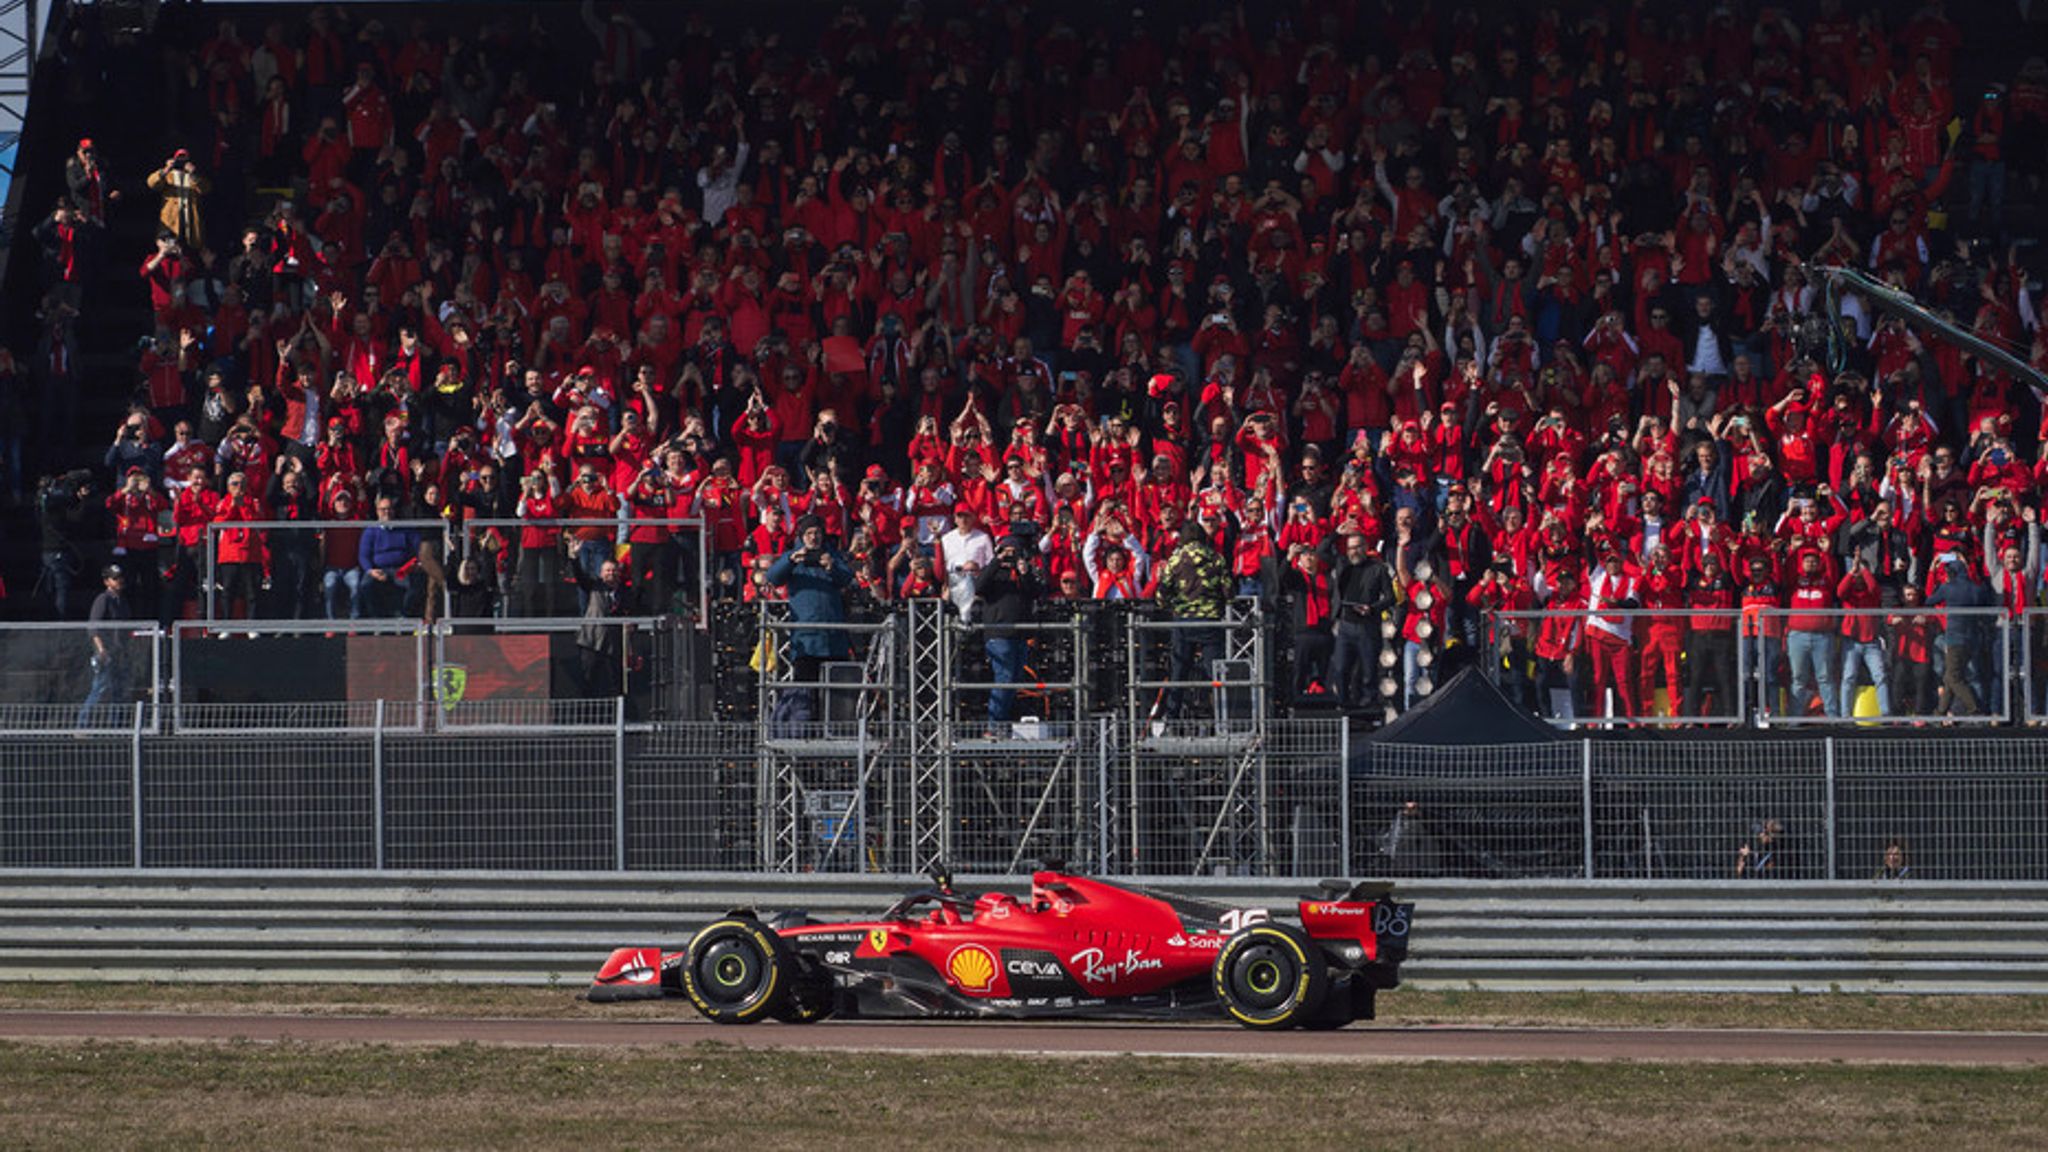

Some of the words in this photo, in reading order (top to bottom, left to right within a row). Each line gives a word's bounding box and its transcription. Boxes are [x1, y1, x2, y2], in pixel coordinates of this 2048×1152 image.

[838, 933, 864, 942] MILLE
[1188, 935, 1224, 949] Sant
[1071, 947, 1163, 984] Ray-Ban
